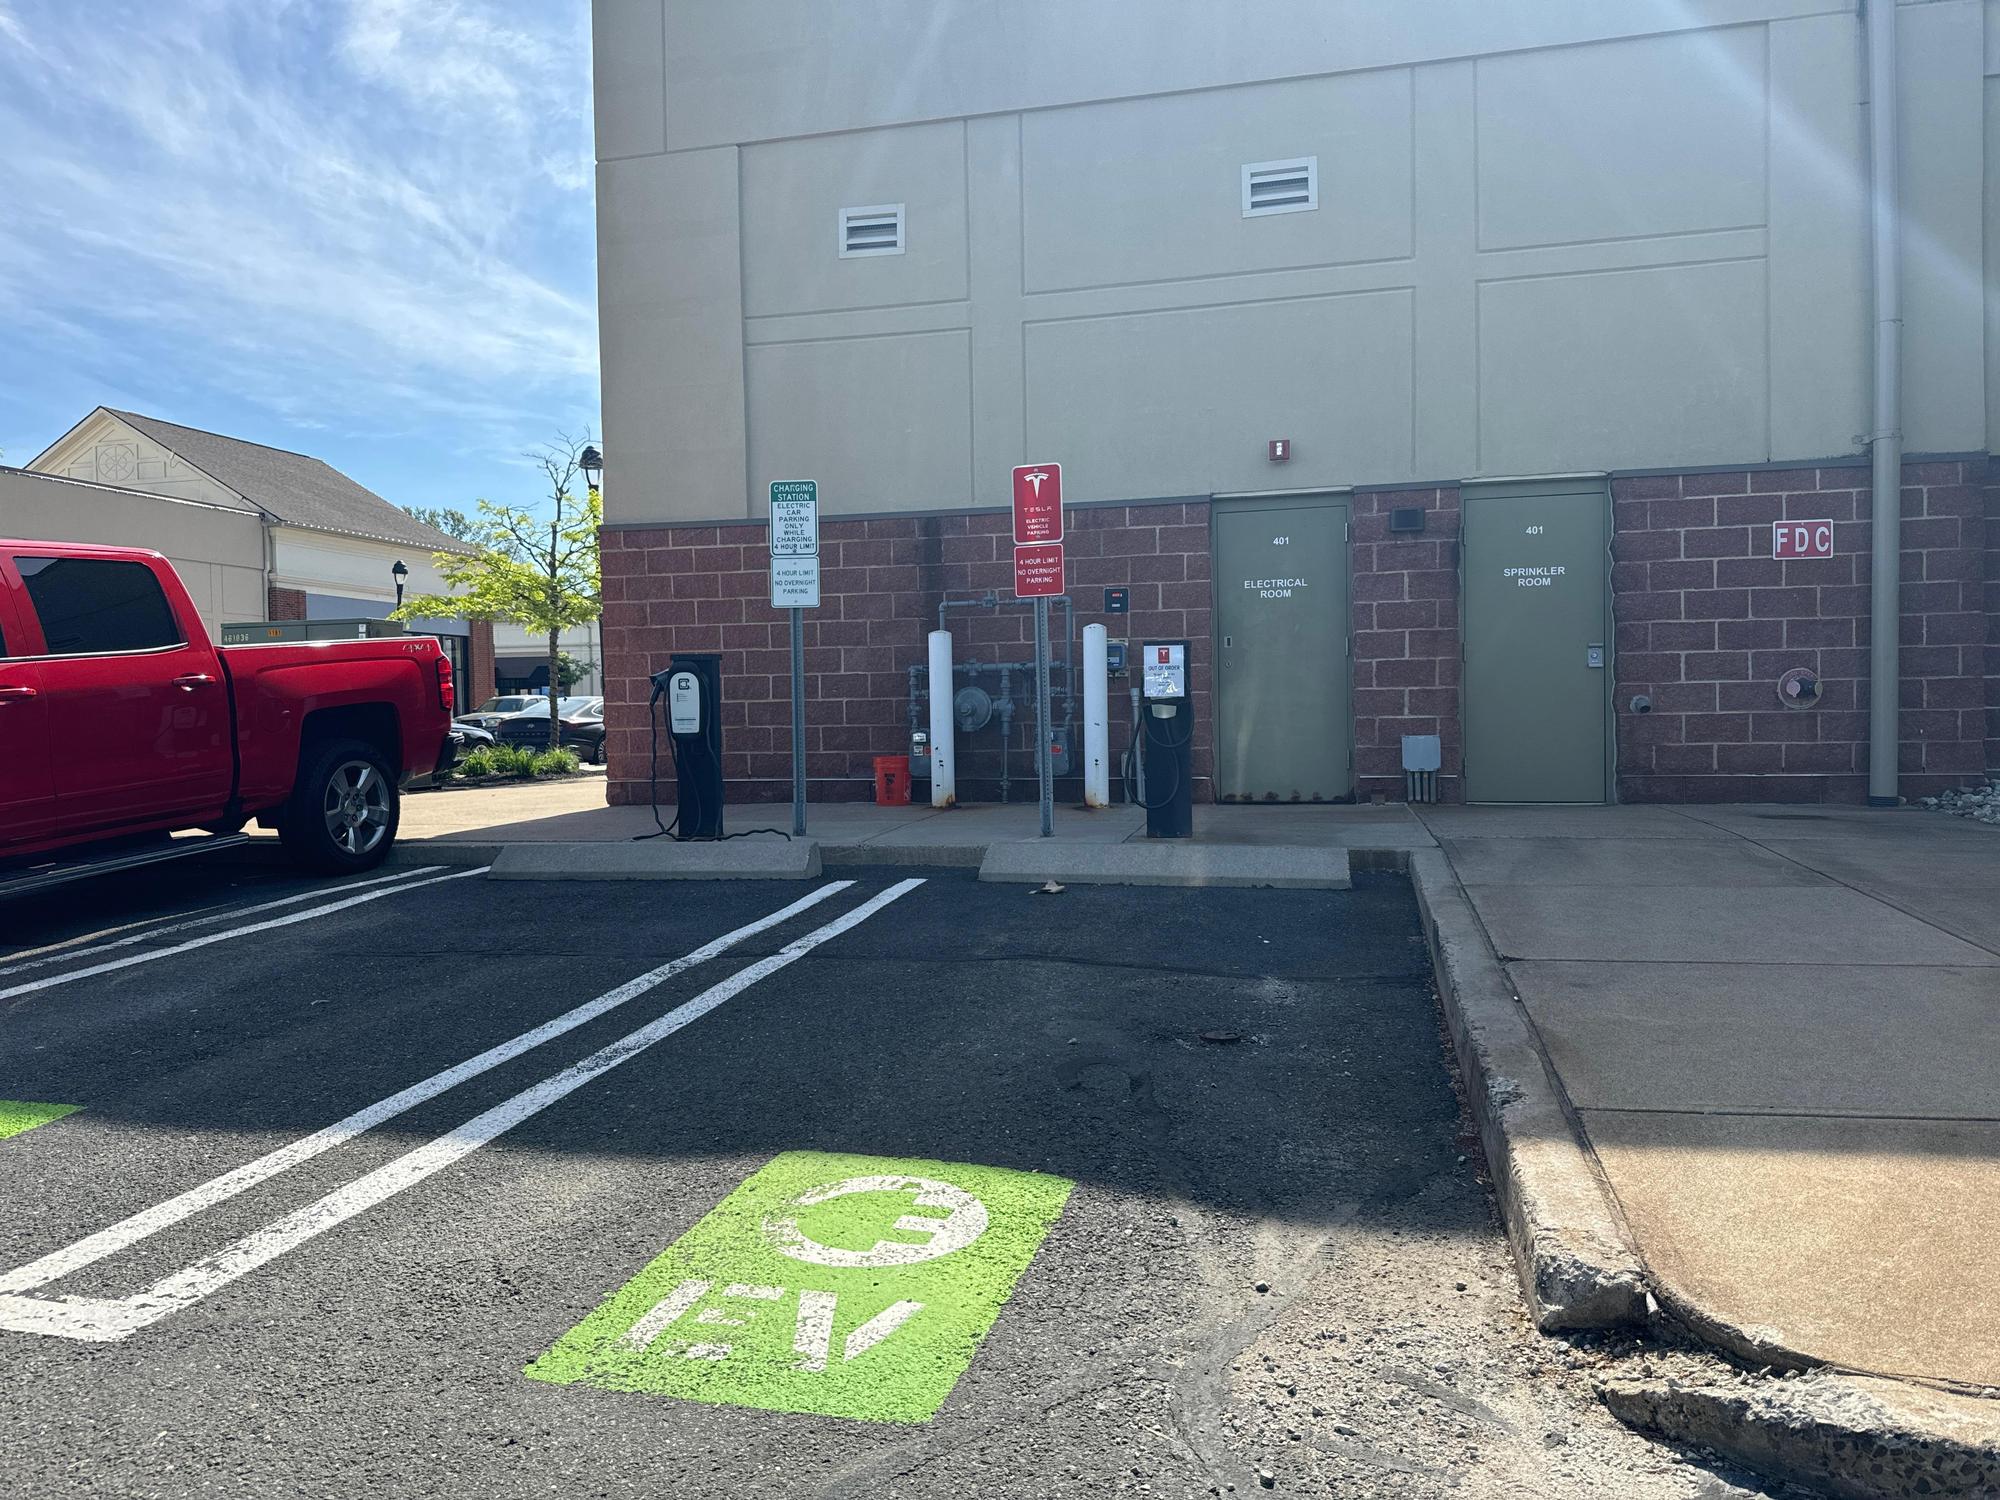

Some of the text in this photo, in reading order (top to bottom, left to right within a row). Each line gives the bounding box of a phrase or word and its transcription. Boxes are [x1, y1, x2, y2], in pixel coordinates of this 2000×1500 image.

[773, 483, 814, 492] CHARGING
[778, 493, 810, 501] STATION
[1526, 525, 1543, 534] 401
[1273, 536, 1288, 545] 401
[1503, 566, 1566, 577] SPRINKLER
[1244, 578, 1308, 589] ELECTRICAL
[1518, 577, 1551, 587] ROOM
[1260, 589, 1292, 598] ROOM
[614, 1278, 927, 1373] EV
